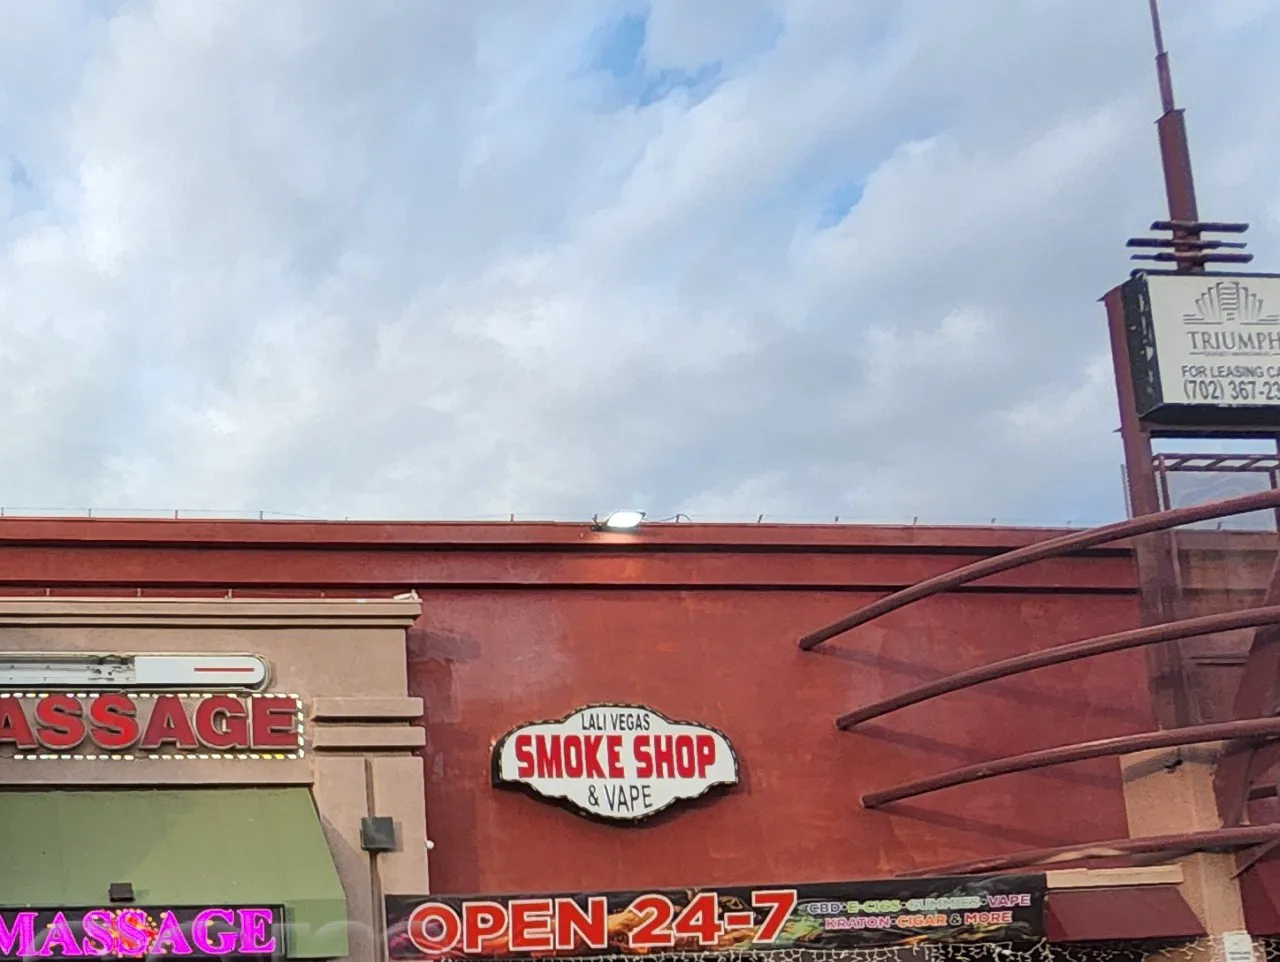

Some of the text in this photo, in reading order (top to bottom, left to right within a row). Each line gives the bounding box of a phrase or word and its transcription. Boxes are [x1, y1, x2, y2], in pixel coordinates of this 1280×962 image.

[1186, 331, 1280, 350] TRIUMPH
[1181, 365, 1208, 379] FOR
[1210, 365, 1265, 379] LEASING
[1184, 379, 1225, 401] (702)
[581, 713, 651, 732] LALI VEGAS
[515, 734, 716, 780] SMOKE SHOP
[588, 784, 653, 812] & VAPE
[808, 893, 1032, 915] CBD E-CIGS GUMMIES VAPE
[407, 889, 799, 955] OPEN 24-7
[896, 914, 948, 928] CIGAR
[950, 913, 962, 926] &
[964, 911, 1013, 925] MORE
